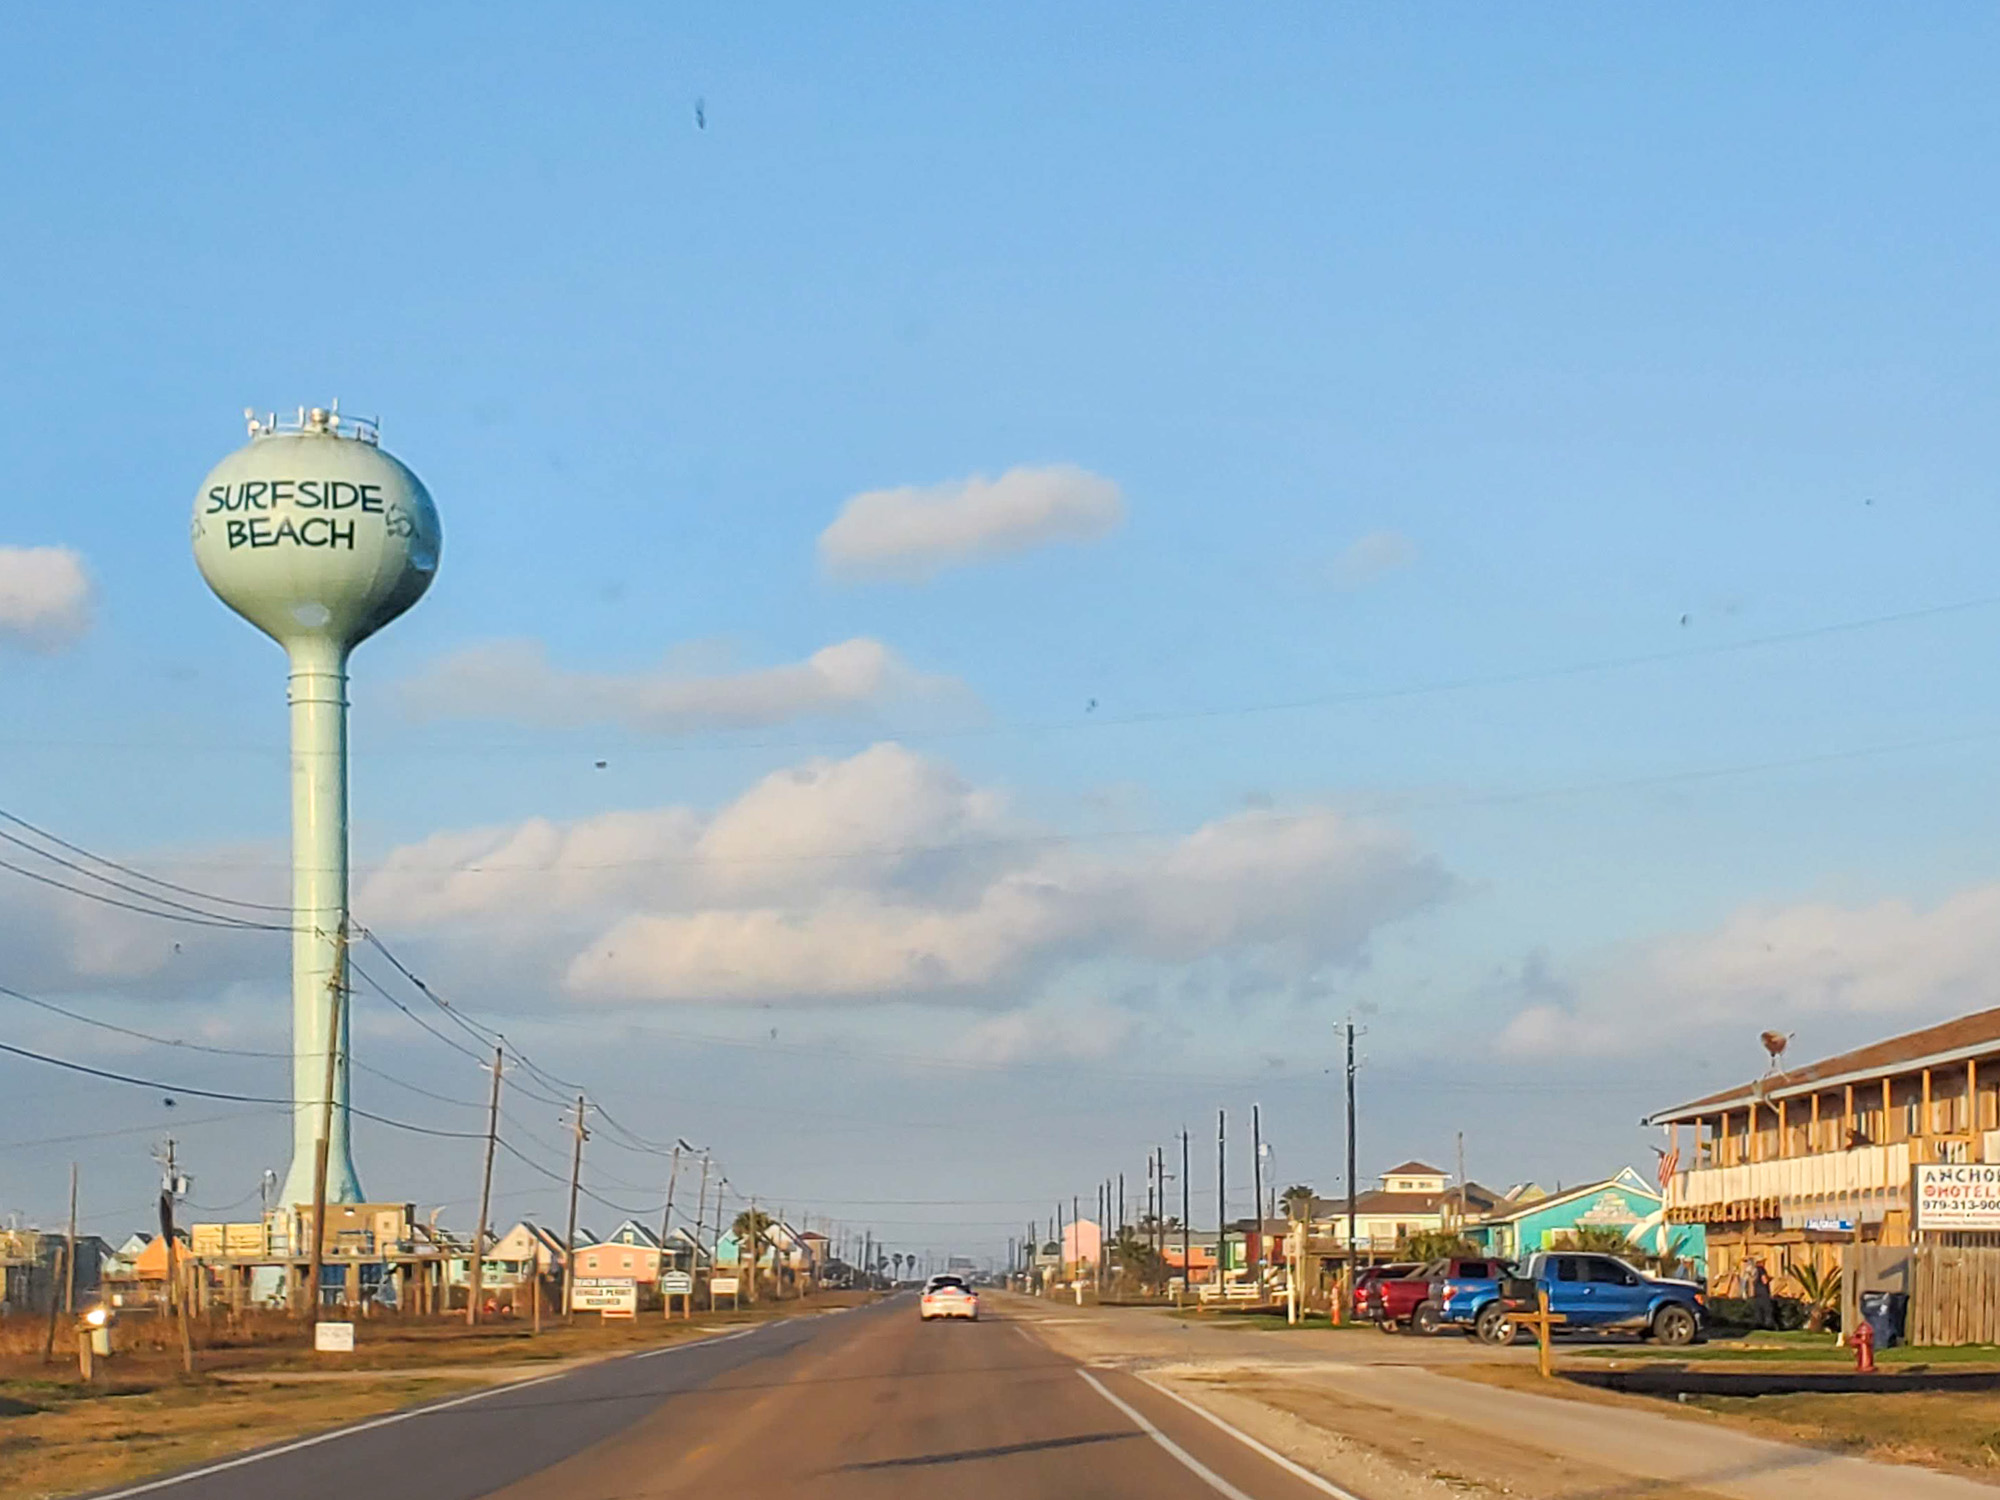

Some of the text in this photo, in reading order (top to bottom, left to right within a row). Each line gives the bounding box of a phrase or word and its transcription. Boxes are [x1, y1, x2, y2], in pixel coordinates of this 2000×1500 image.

[205, 481, 384, 514] SURFSIDE
[227, 517, 355, 550] BEACH
[1924, 1168, 2000, 1183] ANCHO
